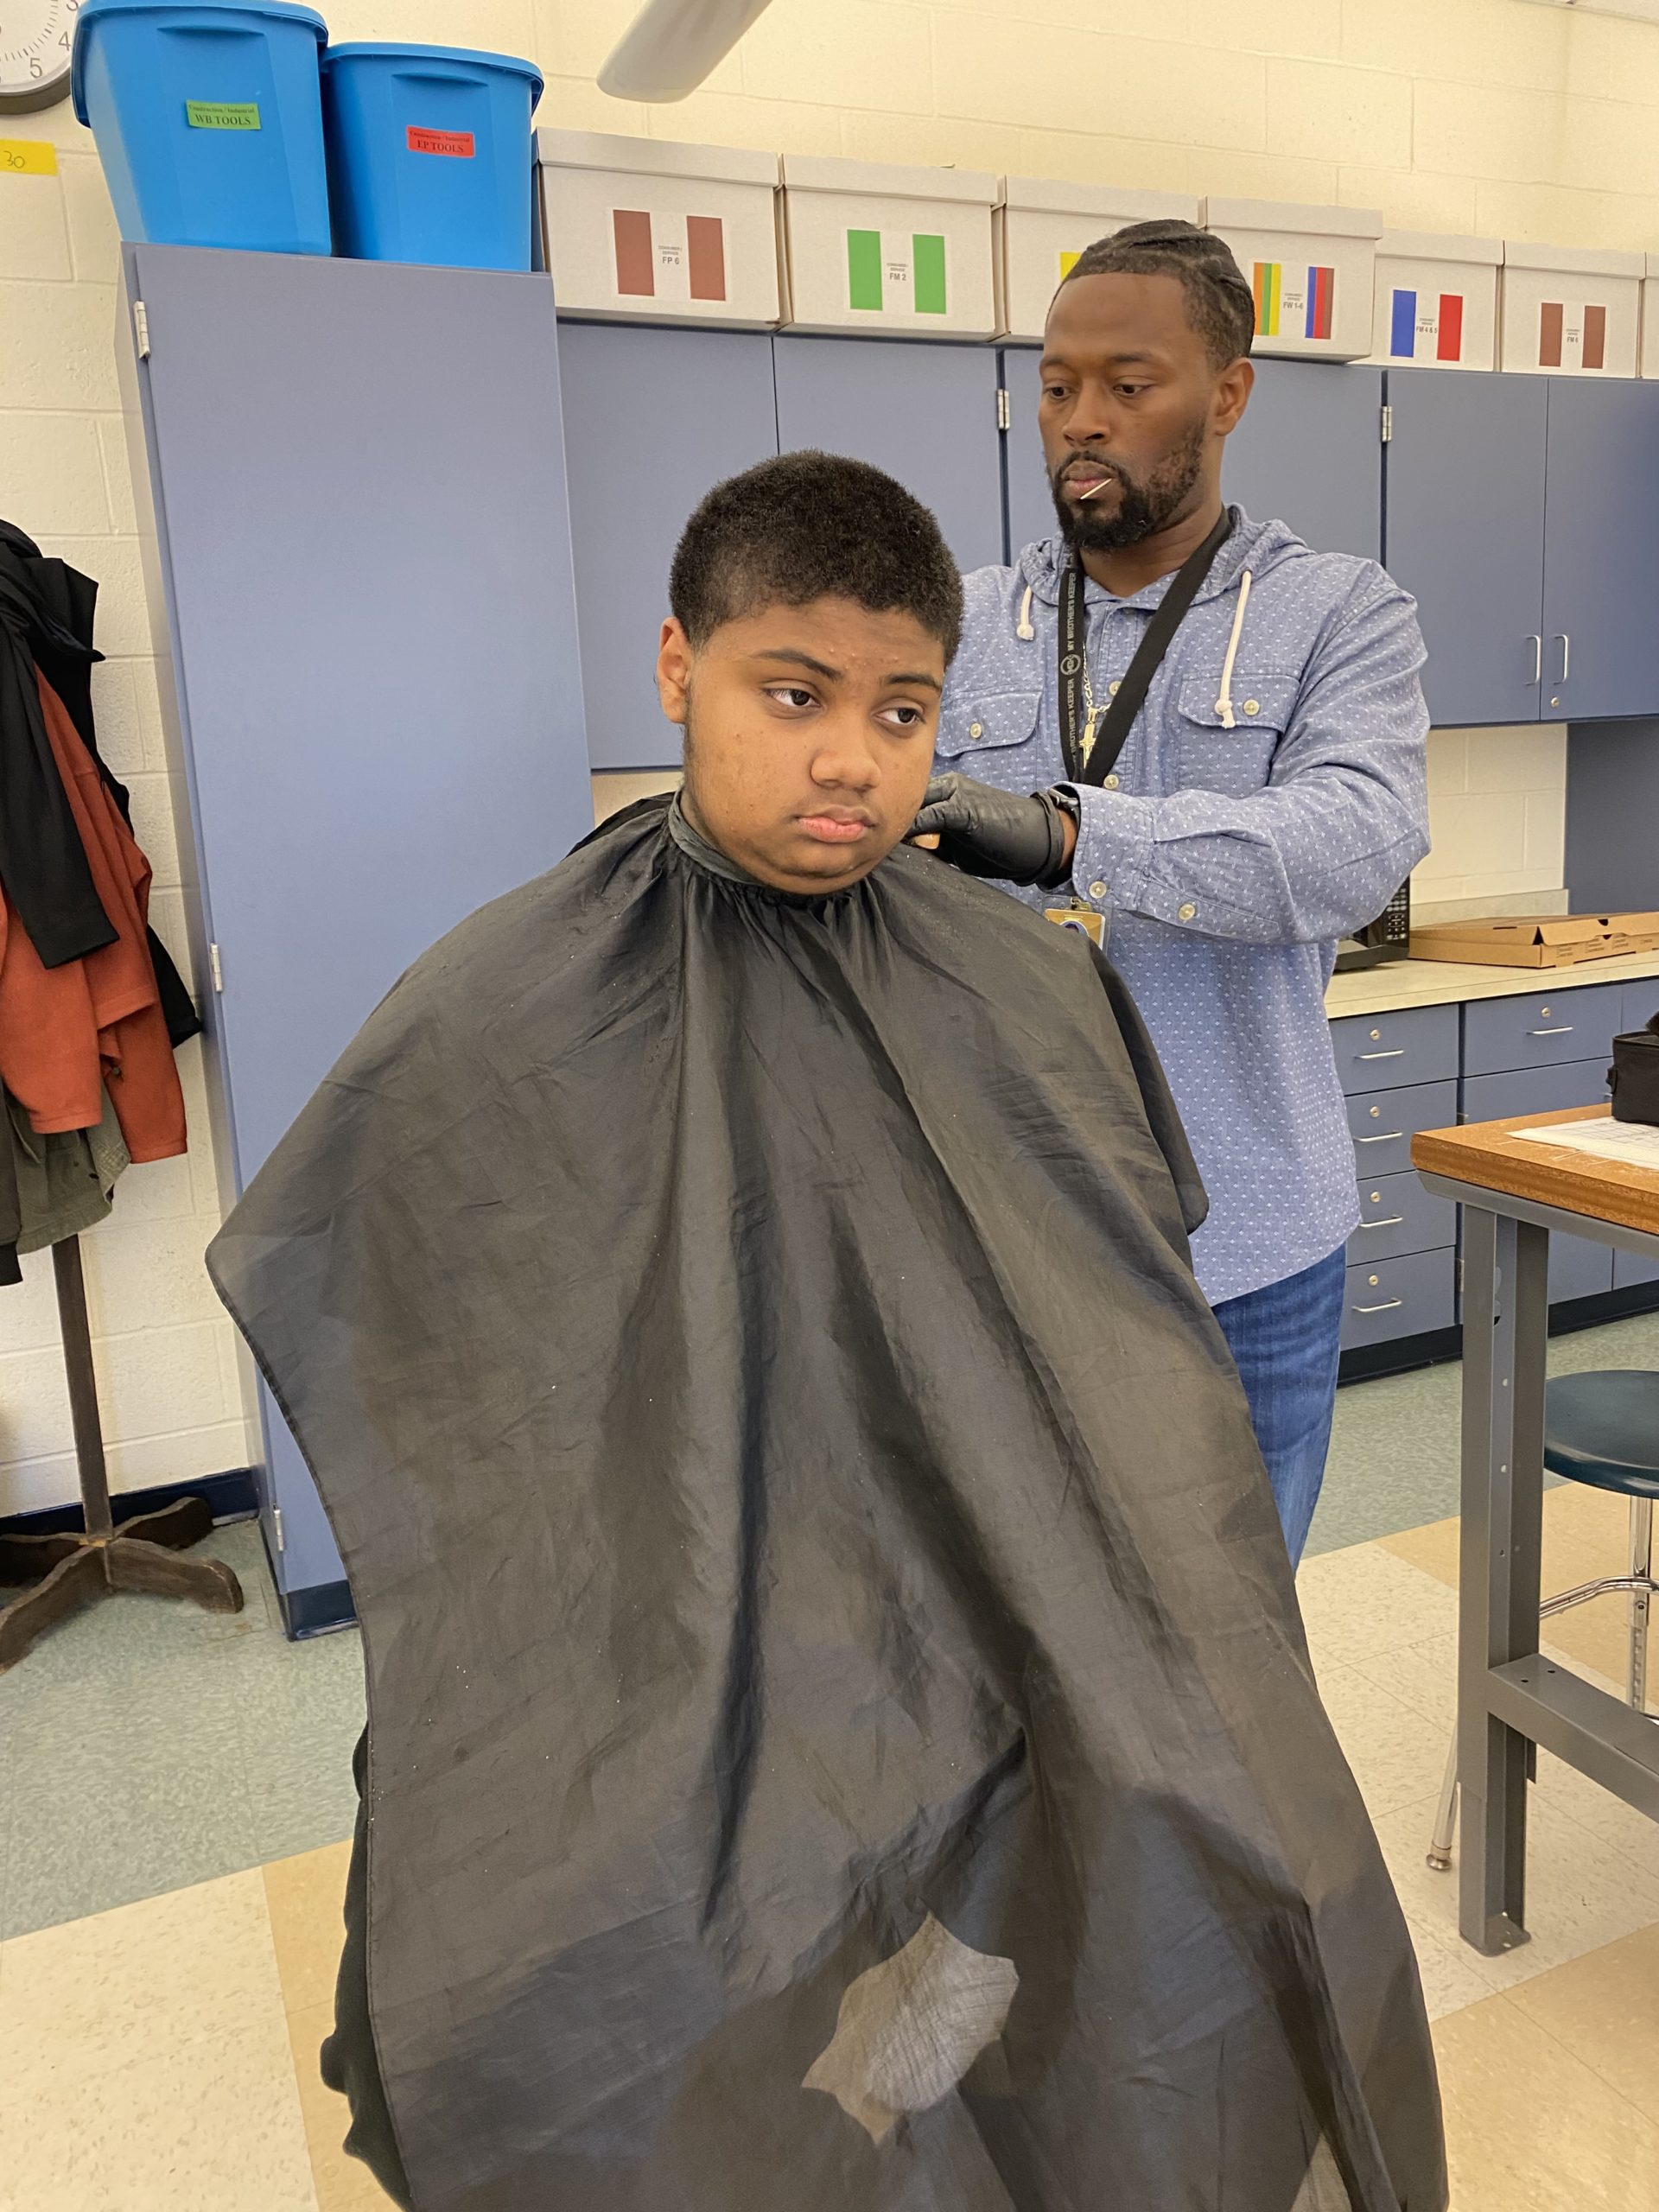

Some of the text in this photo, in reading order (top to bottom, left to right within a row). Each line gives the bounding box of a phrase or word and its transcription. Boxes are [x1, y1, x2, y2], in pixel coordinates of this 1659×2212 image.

[58, 31, 71, 51] 4
[29, 57, 42, 79] 5
[195, 114, 250, 125] WB TOOLS
[430, 142, 464, 153] TOOLS
[3, 150, 25, 168] 30
[662, 256, 673, 264] FP
[890, 272, 900, 281] FM
[1068, 572, 1077, 599] KEEPER
[1067, 640, 1075, 651] MY
